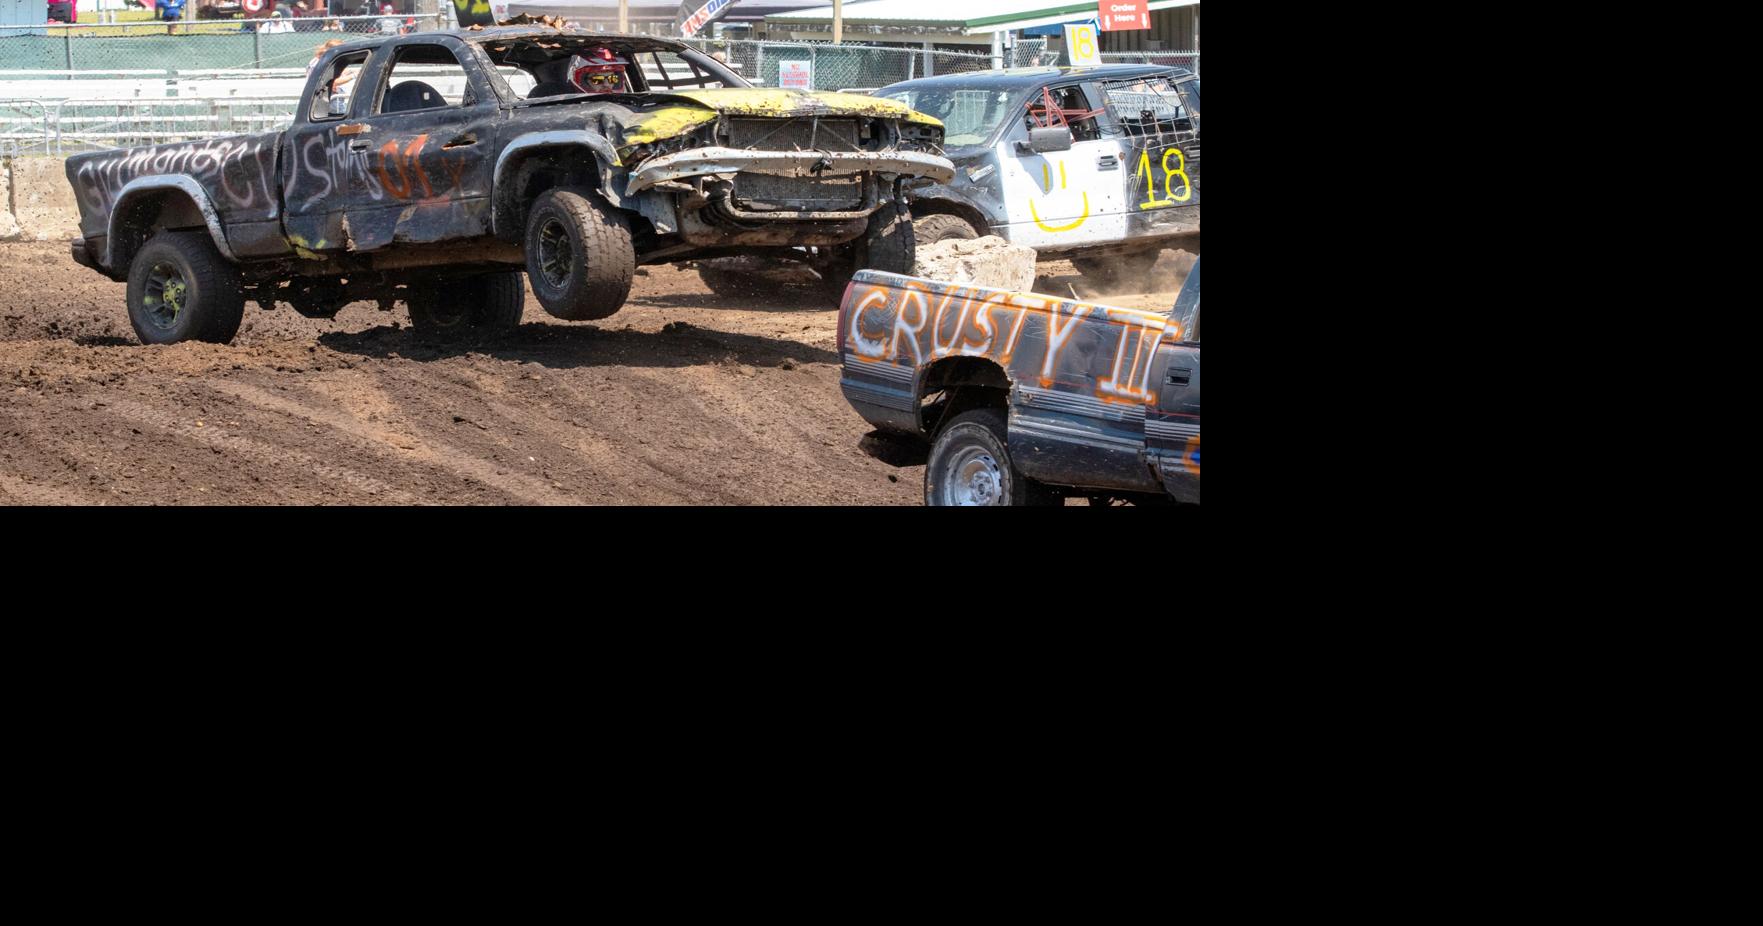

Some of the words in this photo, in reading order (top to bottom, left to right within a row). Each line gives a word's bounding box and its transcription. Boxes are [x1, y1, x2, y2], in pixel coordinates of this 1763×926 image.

[1110, 4, 1136, 12] Order
[1071, 26, 1095, 62] 18
[1137, 147, 1192, 210] 18
[850, 281, 1094, 388] CRUSTY
